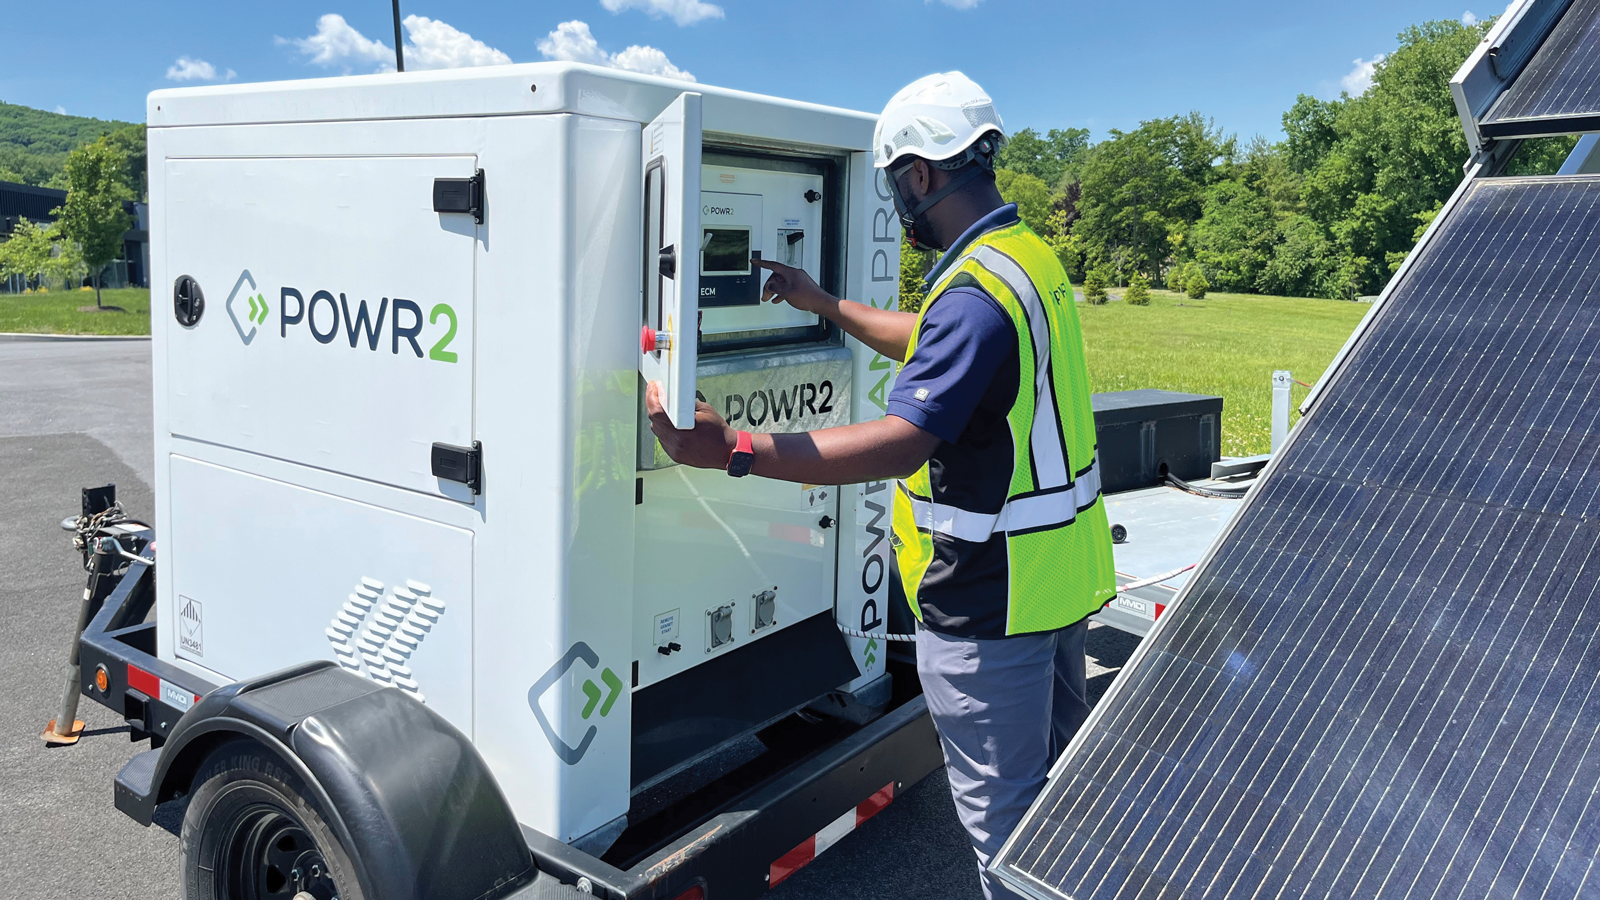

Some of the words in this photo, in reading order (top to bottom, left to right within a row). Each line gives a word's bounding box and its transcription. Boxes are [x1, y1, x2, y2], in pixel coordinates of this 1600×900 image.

[711, 206, 734, 215] POWR2
[700, 287, 716, 296] ECM
[280, 286, 458, 363] POWR2
[725, 379, 833, 427] POWR2
[1119, 597, 1145, 612] MMDI
[180, 635, 201, 651] UN3481
[230, 755, 261, 773] KING
